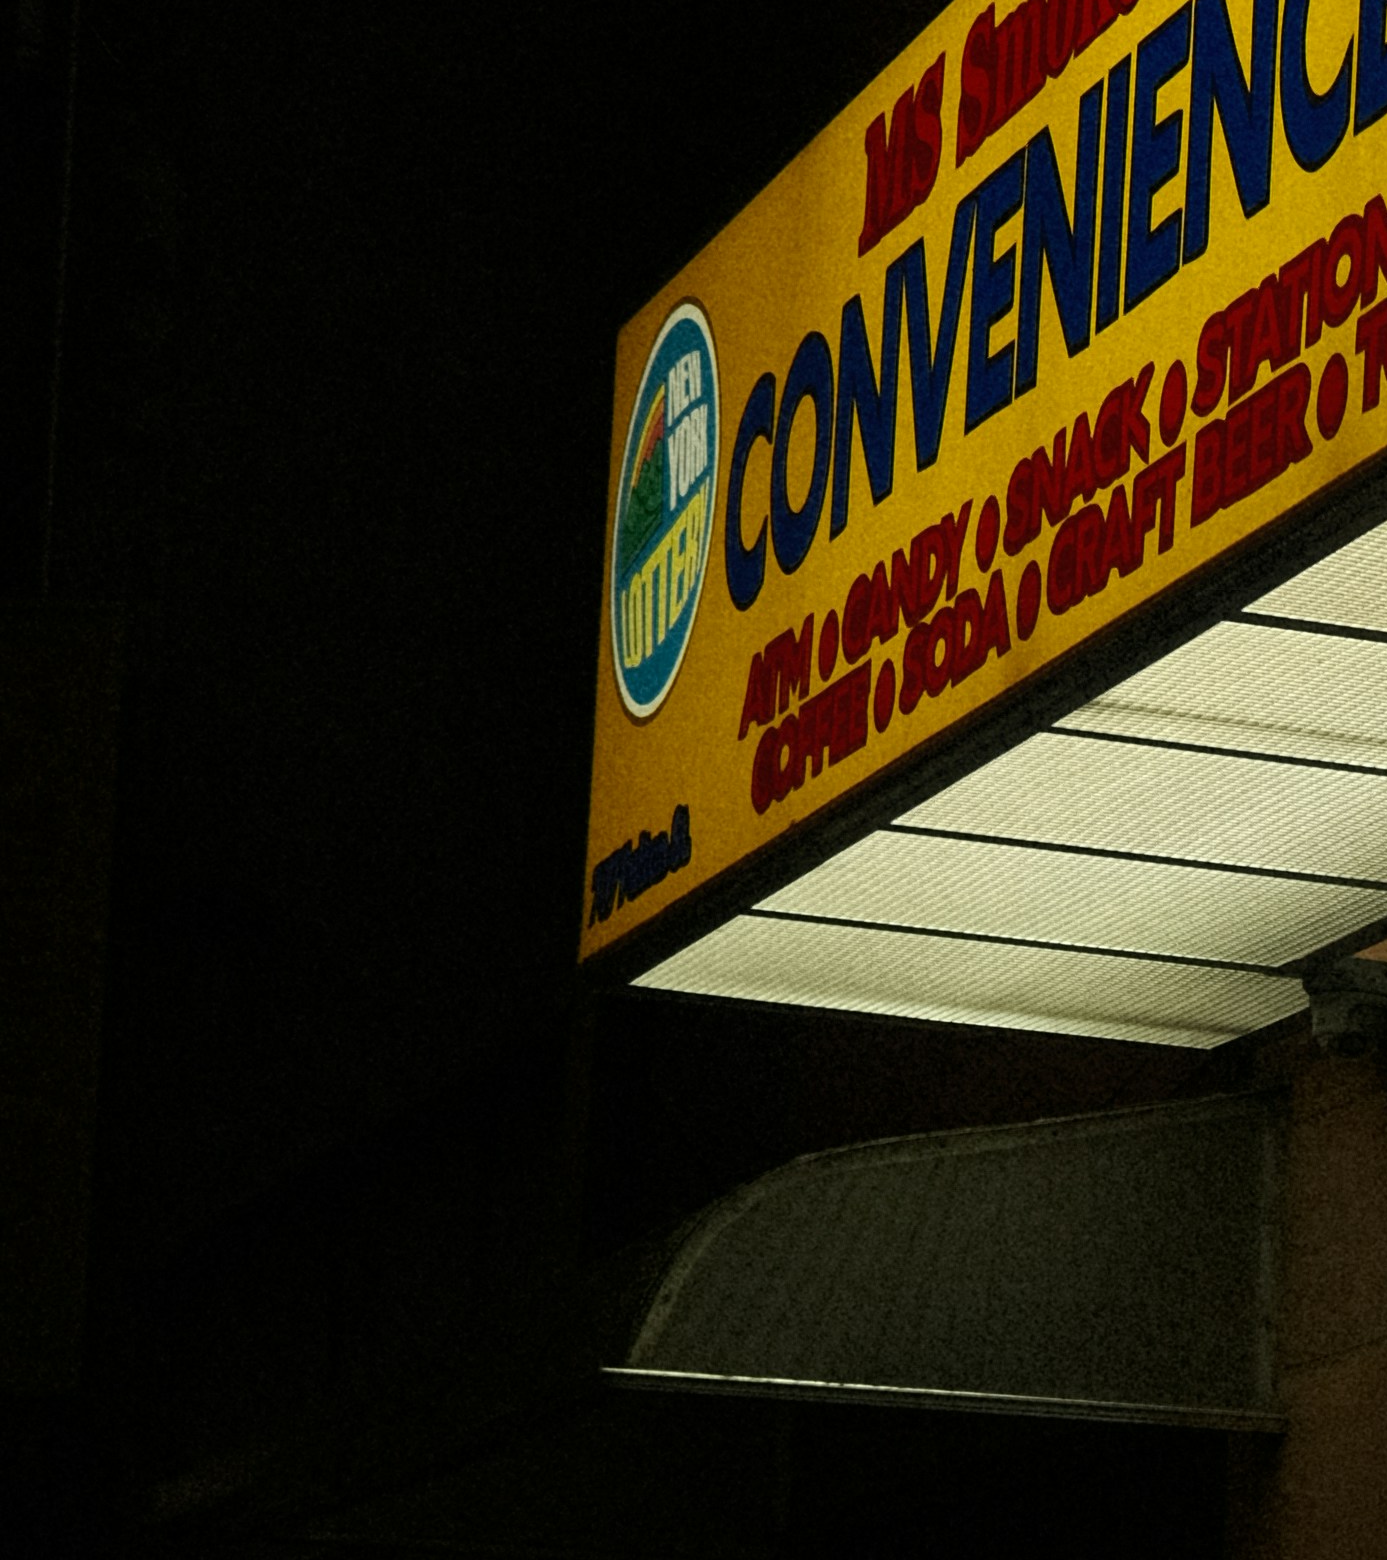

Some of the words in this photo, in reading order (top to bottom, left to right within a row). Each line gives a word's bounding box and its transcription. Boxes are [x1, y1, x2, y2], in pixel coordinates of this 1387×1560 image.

[858, 52, 946, 257] MS
[667, 349, 702, 428] NEW
[667, 403, 708, 511] YORK
[620, 476, 711, 670] LOTTERY
[737, 607, 812, 741] ATM
[841, 498, 973, 668] CANDY
[1003, 361, 1156, 558] SNACK
[750, 669, 873, 816] COFFEE
[898, 568, 1012, 717] SODA
[1047, 443, 1188, 617] CRAFT
[1190, 362, 1313, 530] BEER
